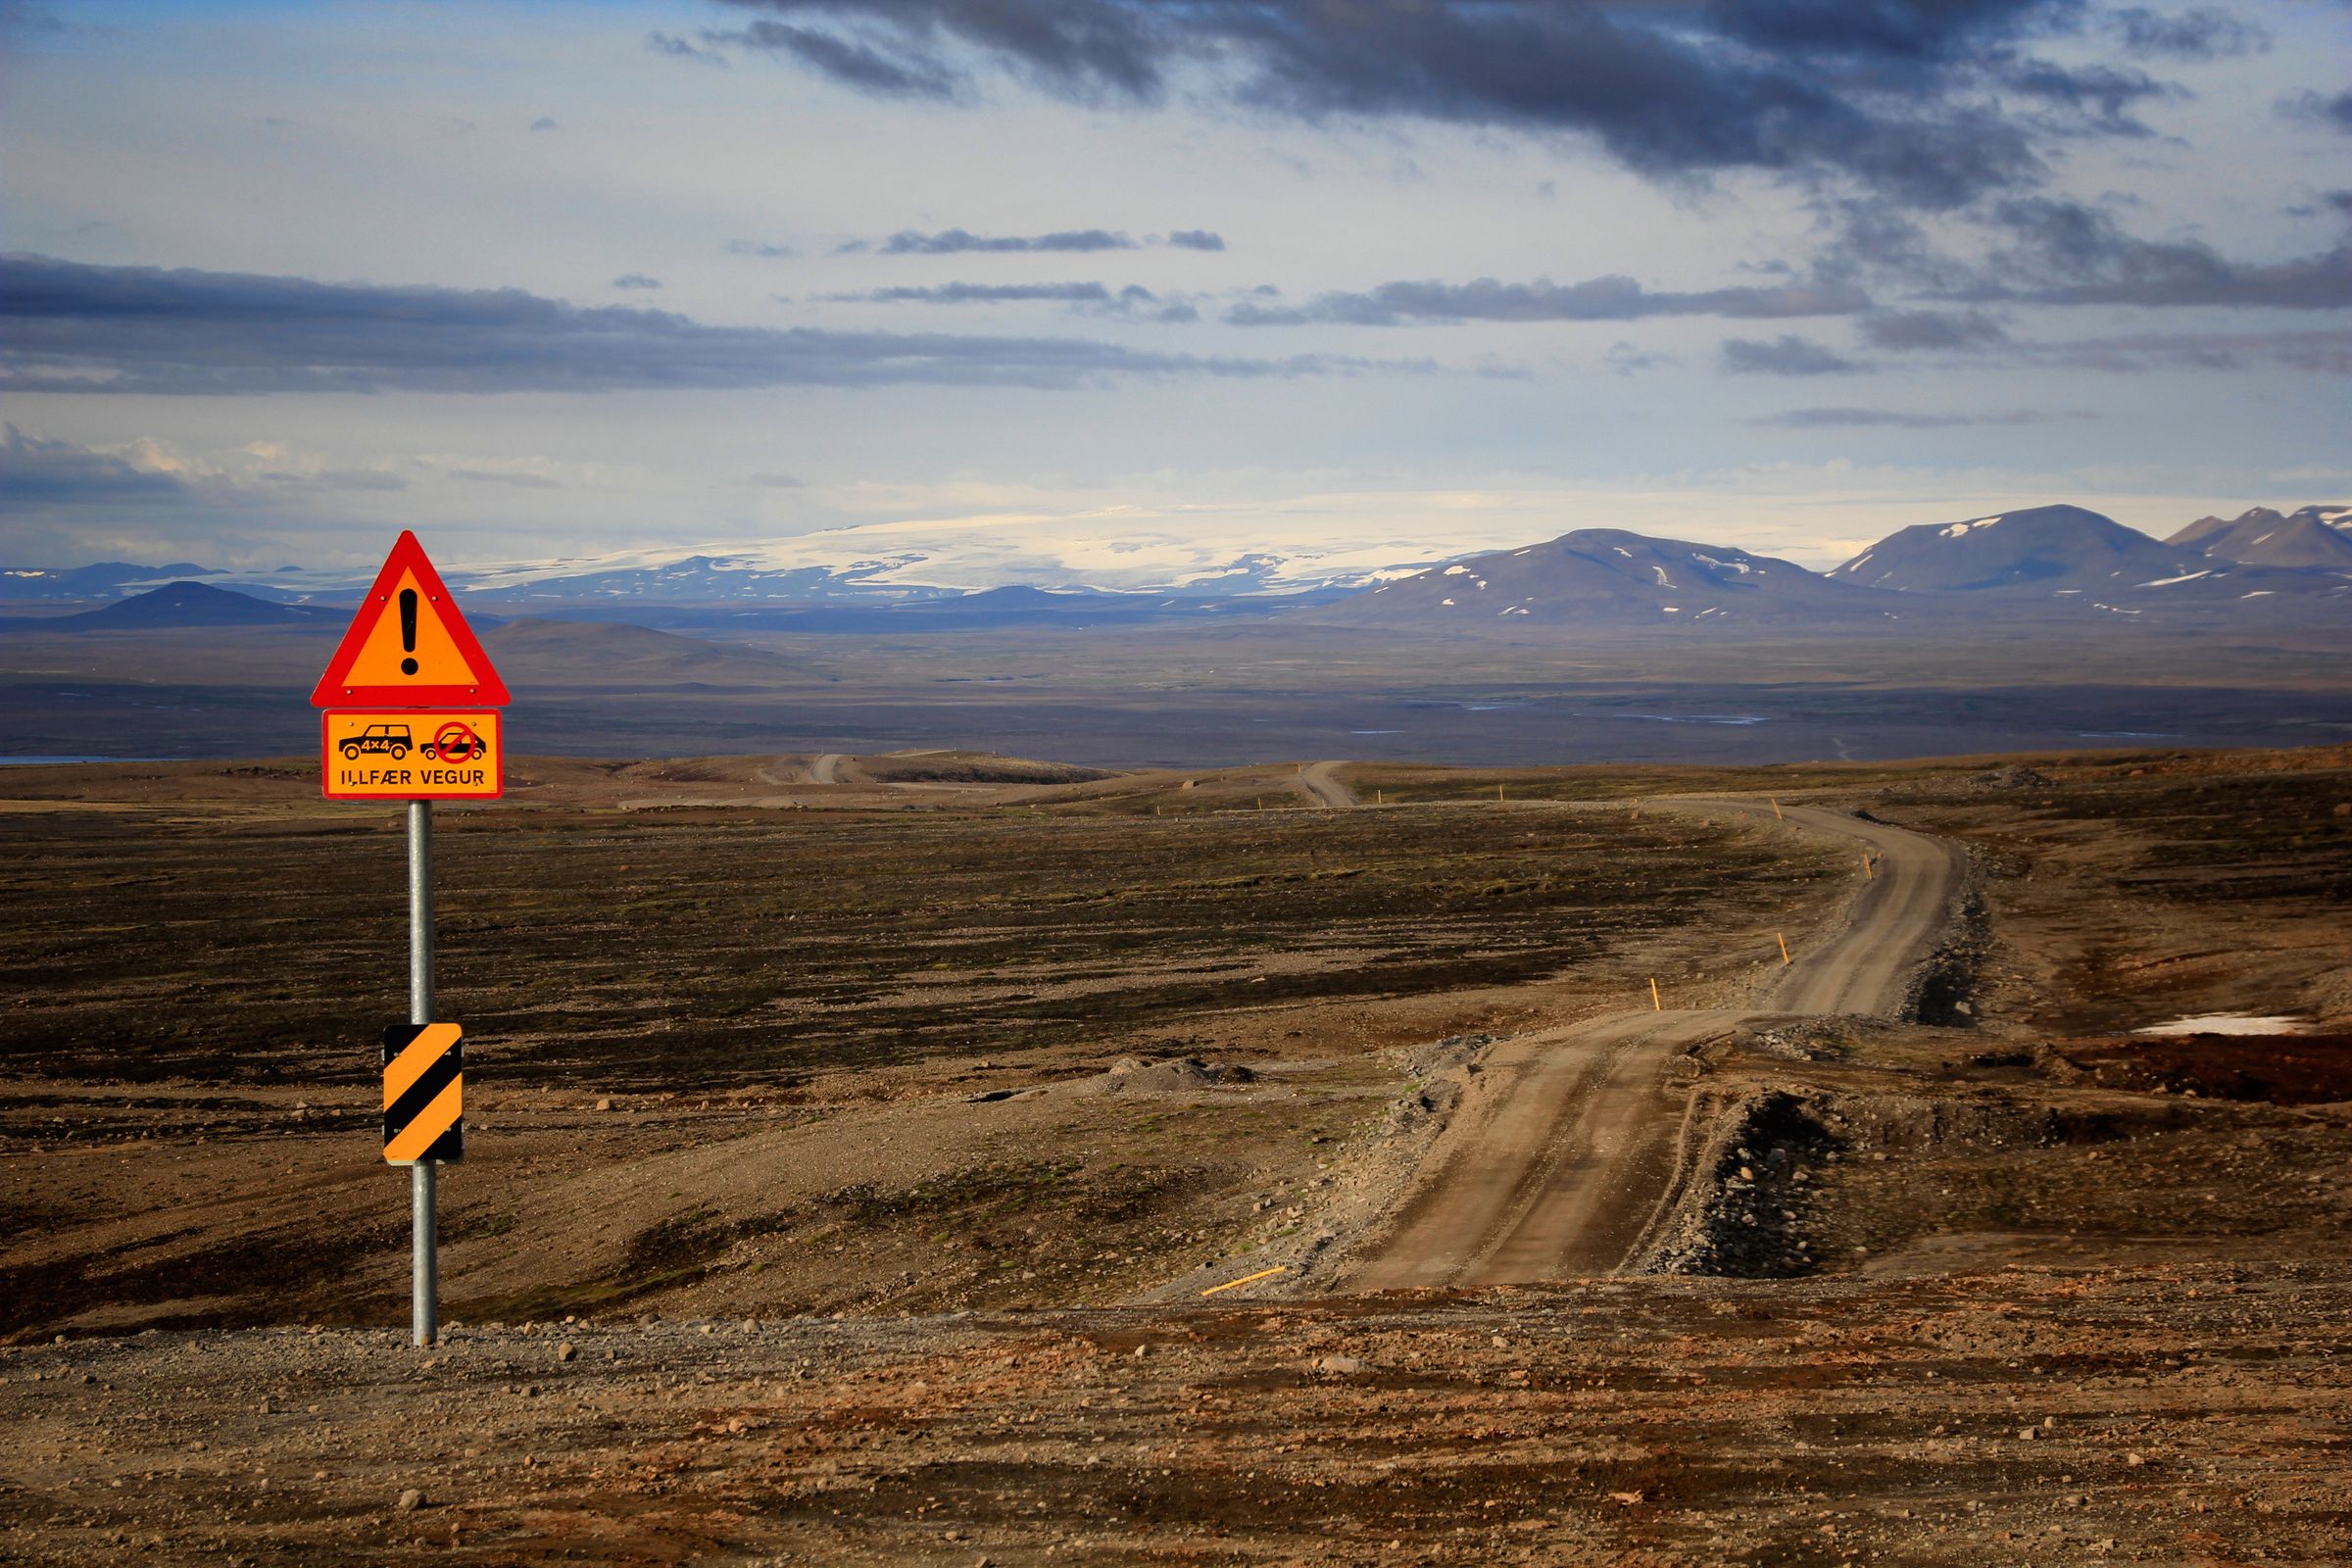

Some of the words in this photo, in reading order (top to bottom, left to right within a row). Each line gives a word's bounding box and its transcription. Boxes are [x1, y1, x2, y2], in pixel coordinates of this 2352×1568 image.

[361, 739, 390, 751] 4x4
[341, 769, 412, 785] ILLFÆR
[420, 769, 484, 785] VEGUR
